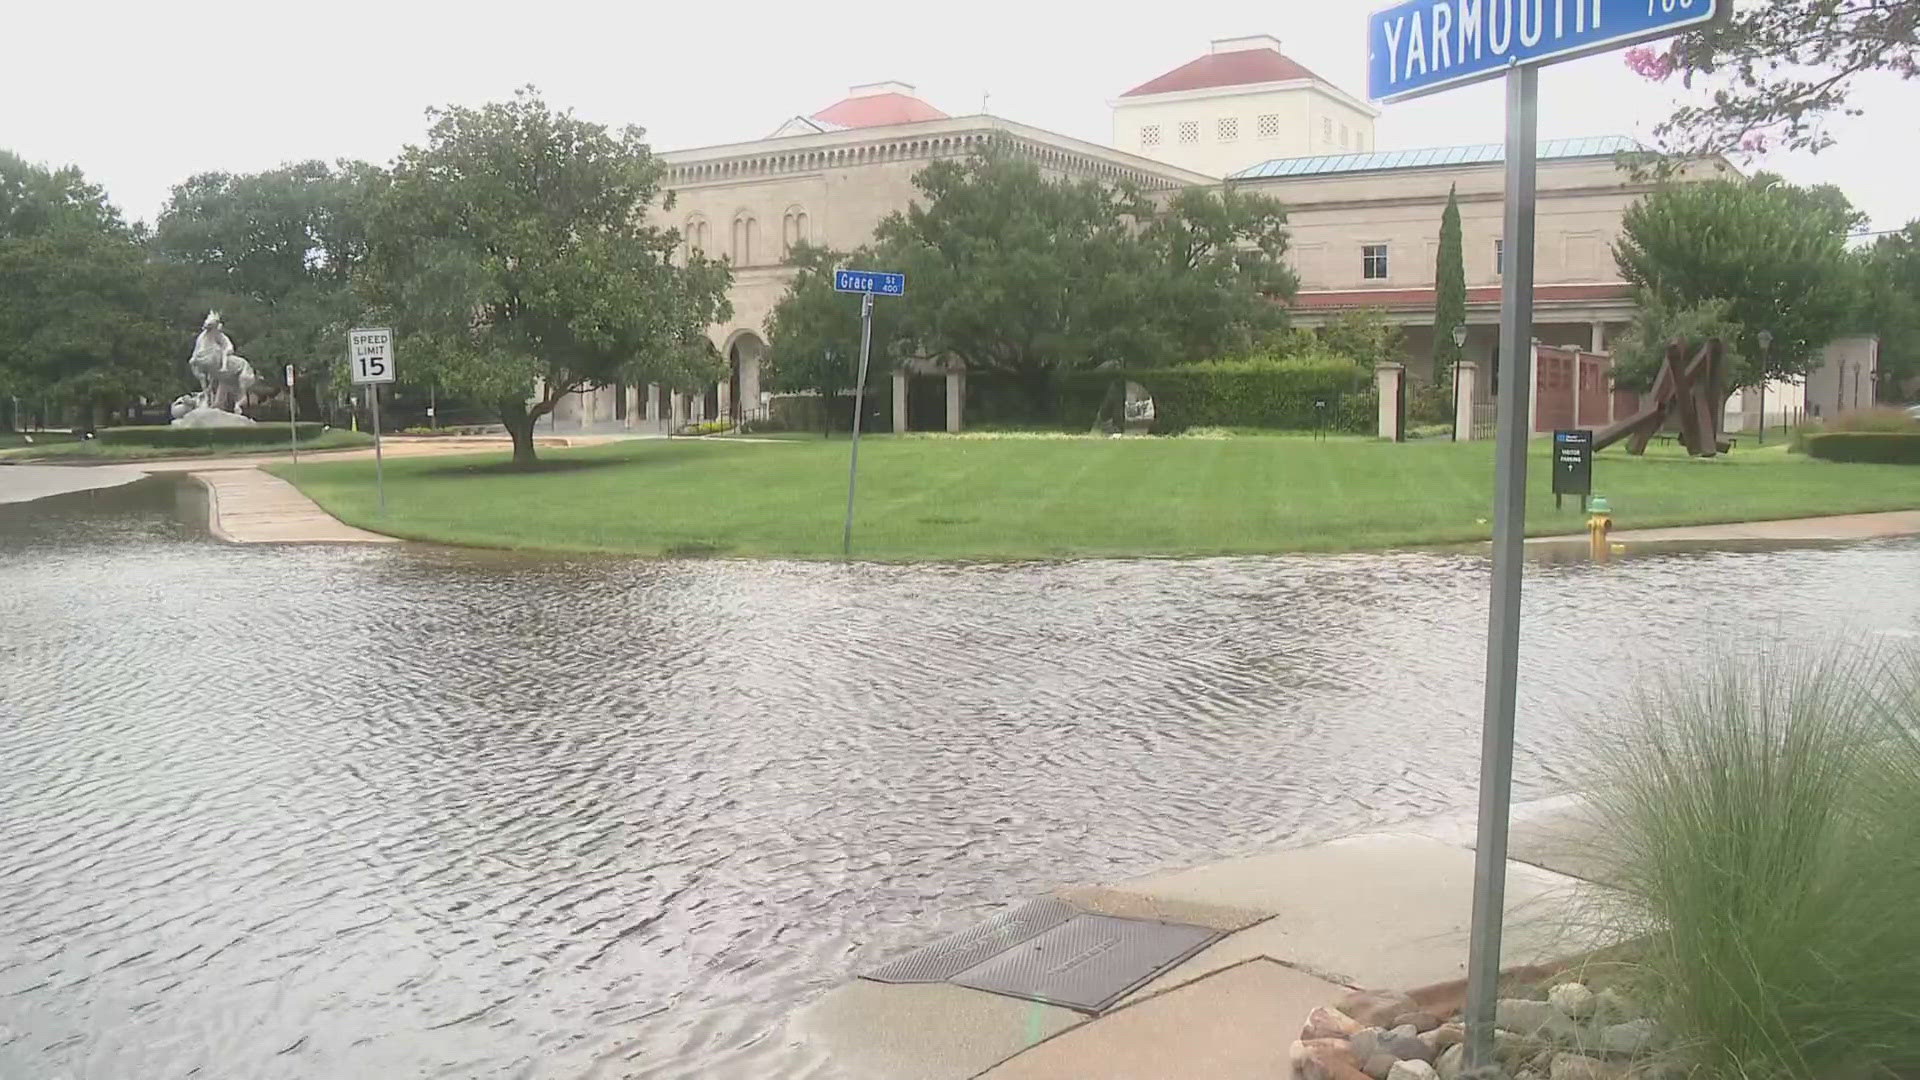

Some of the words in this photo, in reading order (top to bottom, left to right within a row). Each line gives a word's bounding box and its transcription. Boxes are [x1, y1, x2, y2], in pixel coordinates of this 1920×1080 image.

[840, 273, 874, 290] Grace
[885, 276, 896, 285] St
[353, 335, 388, 345] SPEED
[357, 345, 384, 356] LIMIT
[359, 357, 385, 377] 15
